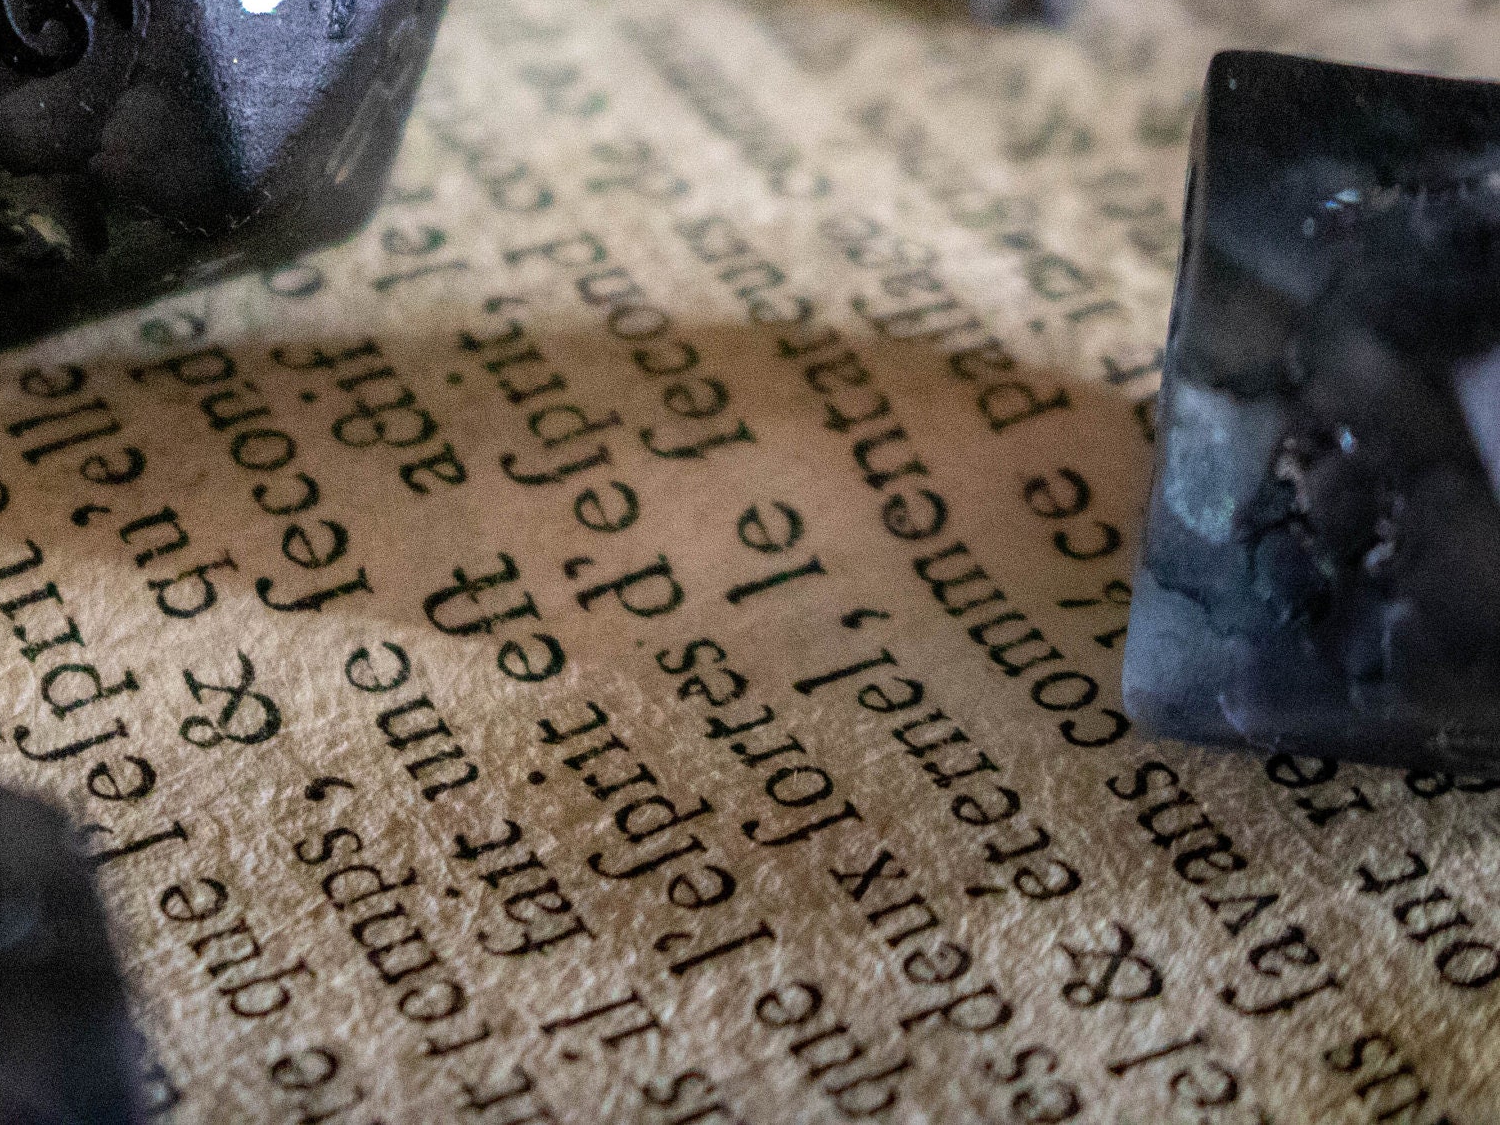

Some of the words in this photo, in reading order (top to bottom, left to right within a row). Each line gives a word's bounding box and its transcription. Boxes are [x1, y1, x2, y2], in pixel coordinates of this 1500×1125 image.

[267, 339, 468, 495] actif
[725, 502, 827, 606] le
[1024, 468, 1124, 562] ce
[179, 653, 284, 750] &
[346, 642, 480, 804] une
[793, 608, 1083, 903] éternel,
[1264, 755, 1375, 828] re
[158, 876, 310, 1020] que
[445, 819, 597, 958] fait
[826, 848, 1014, 1035] deux
[1355, 847, 1500, 993] ont
[540, 988, 671, 1064] il
[1061, 923, 1165, 1009] &
[754, 981, 912, 1120] que
[1106, 1031, 1242, 1110] el
[1323, 1030, 1431, 1125] us
